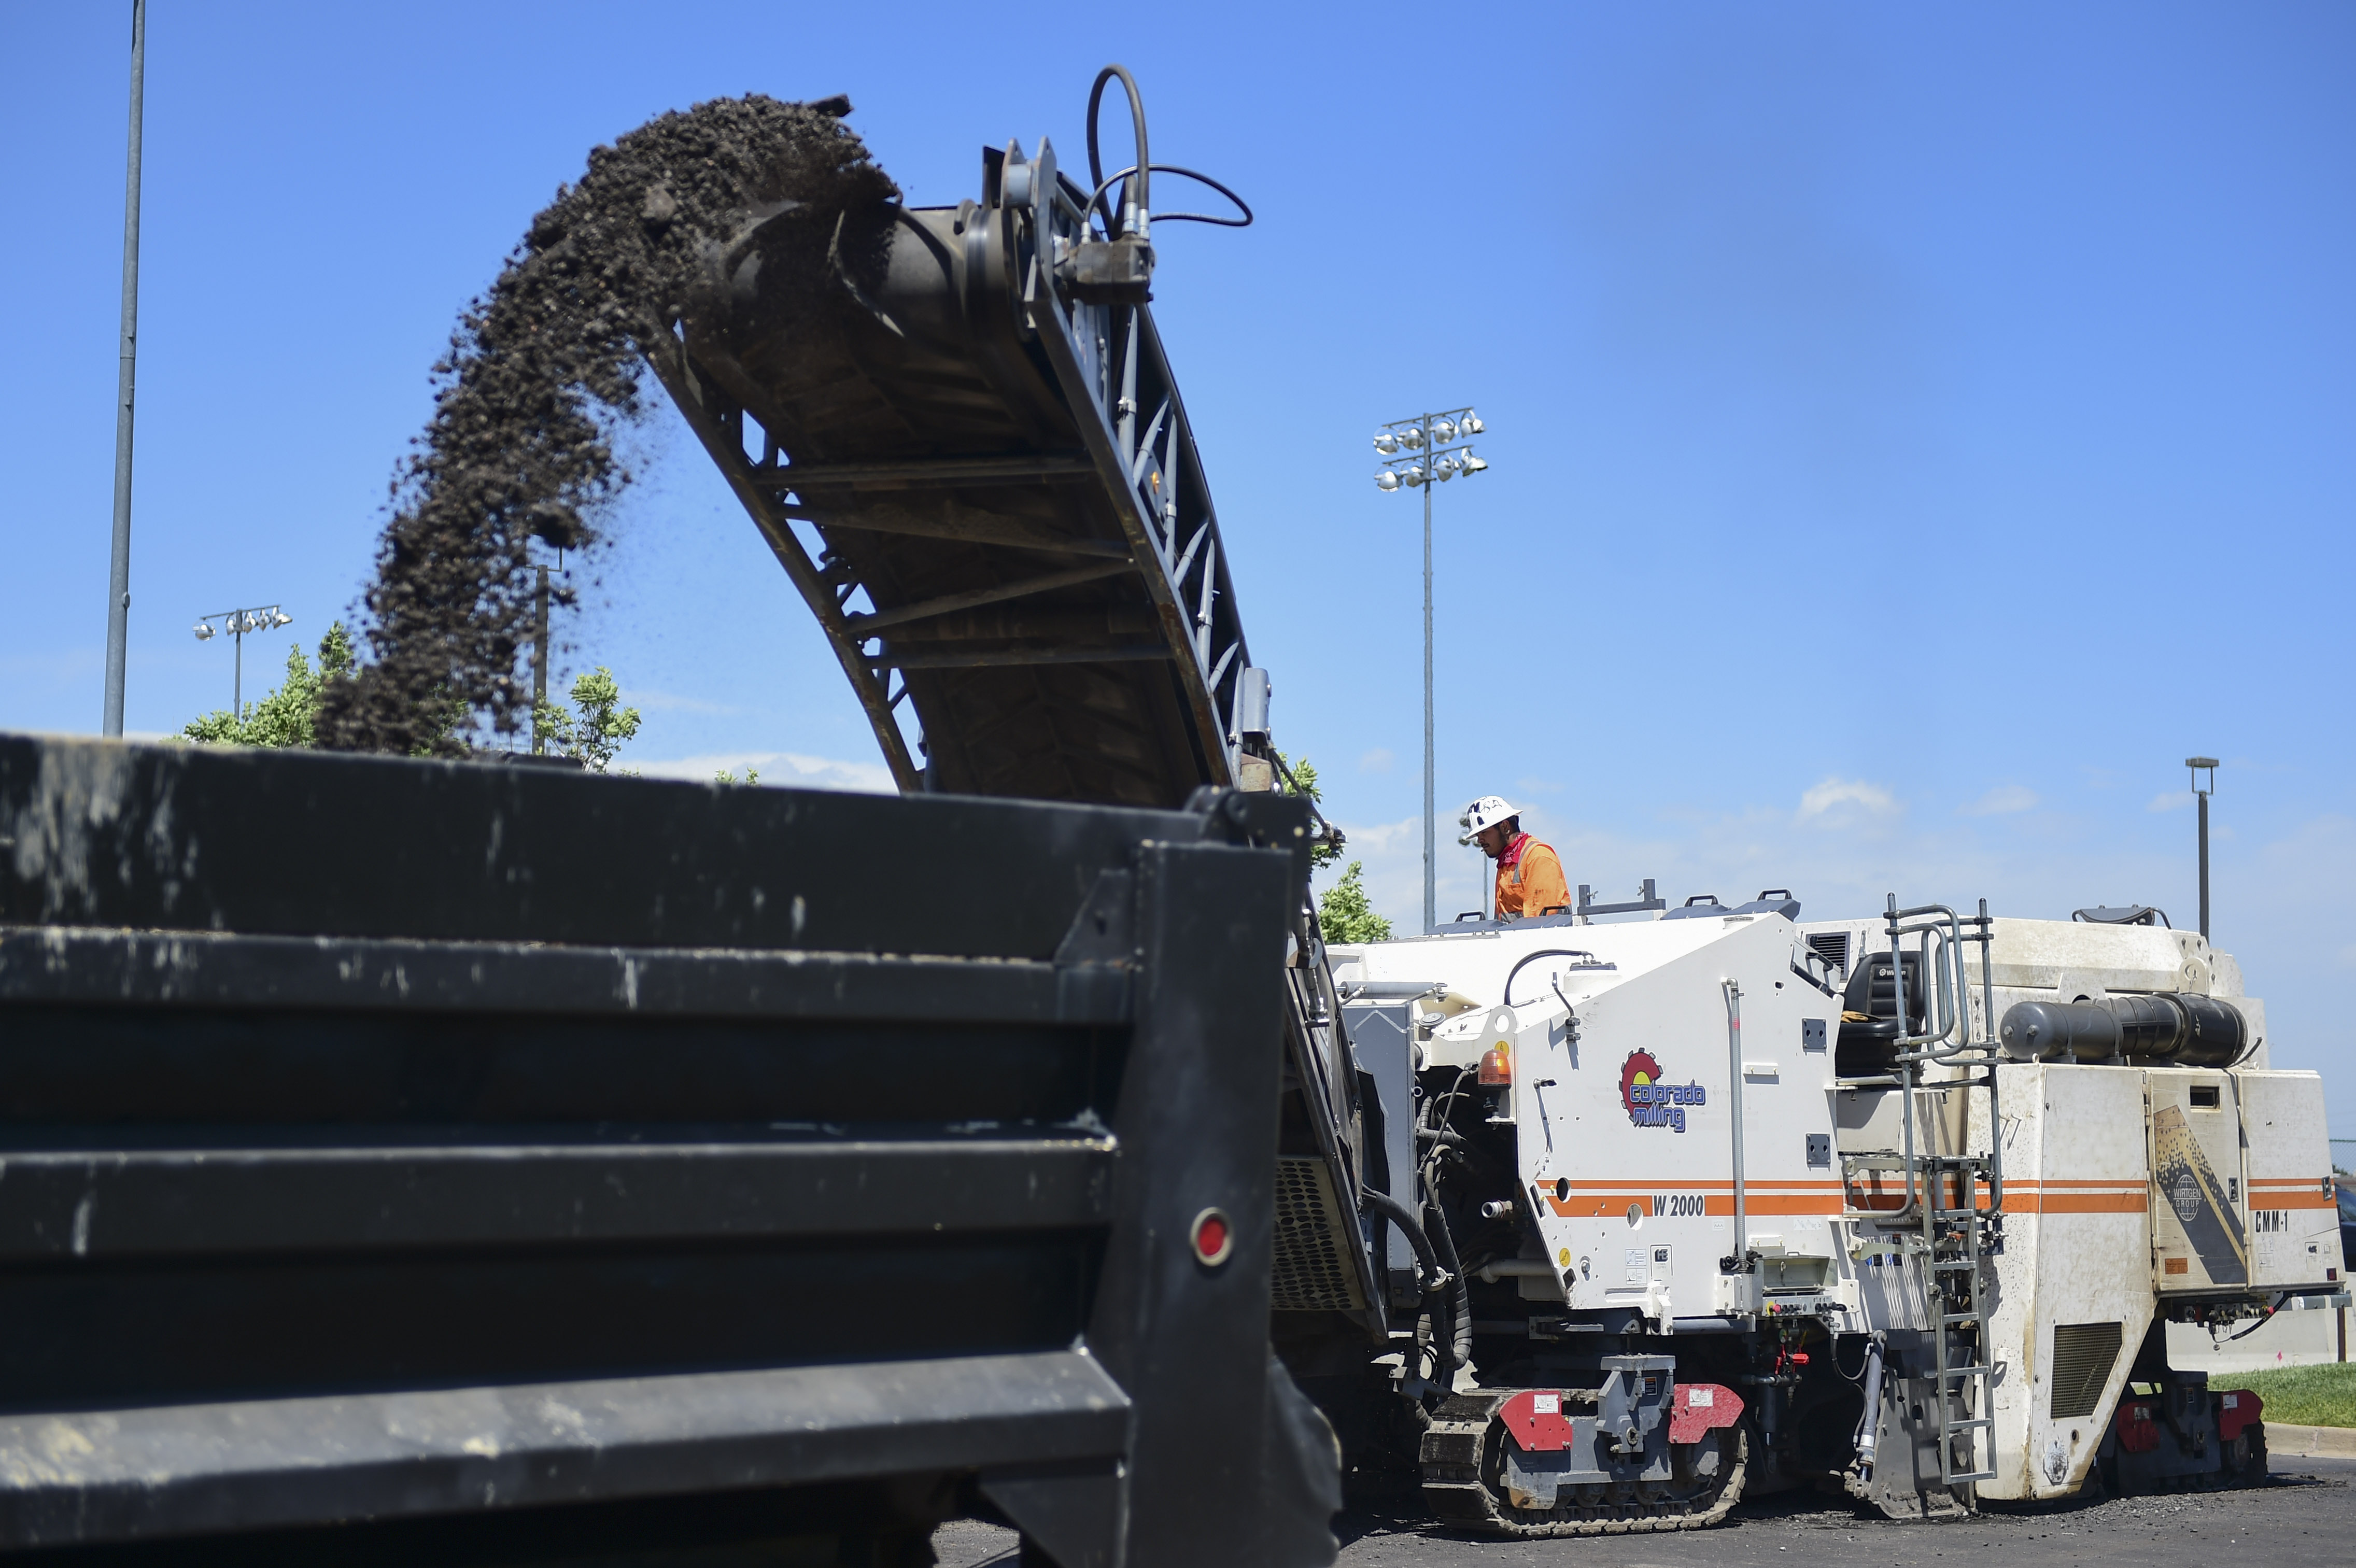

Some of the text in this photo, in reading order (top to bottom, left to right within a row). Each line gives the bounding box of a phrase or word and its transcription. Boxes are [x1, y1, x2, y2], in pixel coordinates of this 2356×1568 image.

[1630, 1079, 1705, 1105] colorado
[1633, 1103, 1685, 1132] milling
[2174, 1188, 2201, 1198] WIRTGEN
[1654, 1195, 1703, 1217] W 2000
[2256, 1210, 2288, 1233] CMM-1
